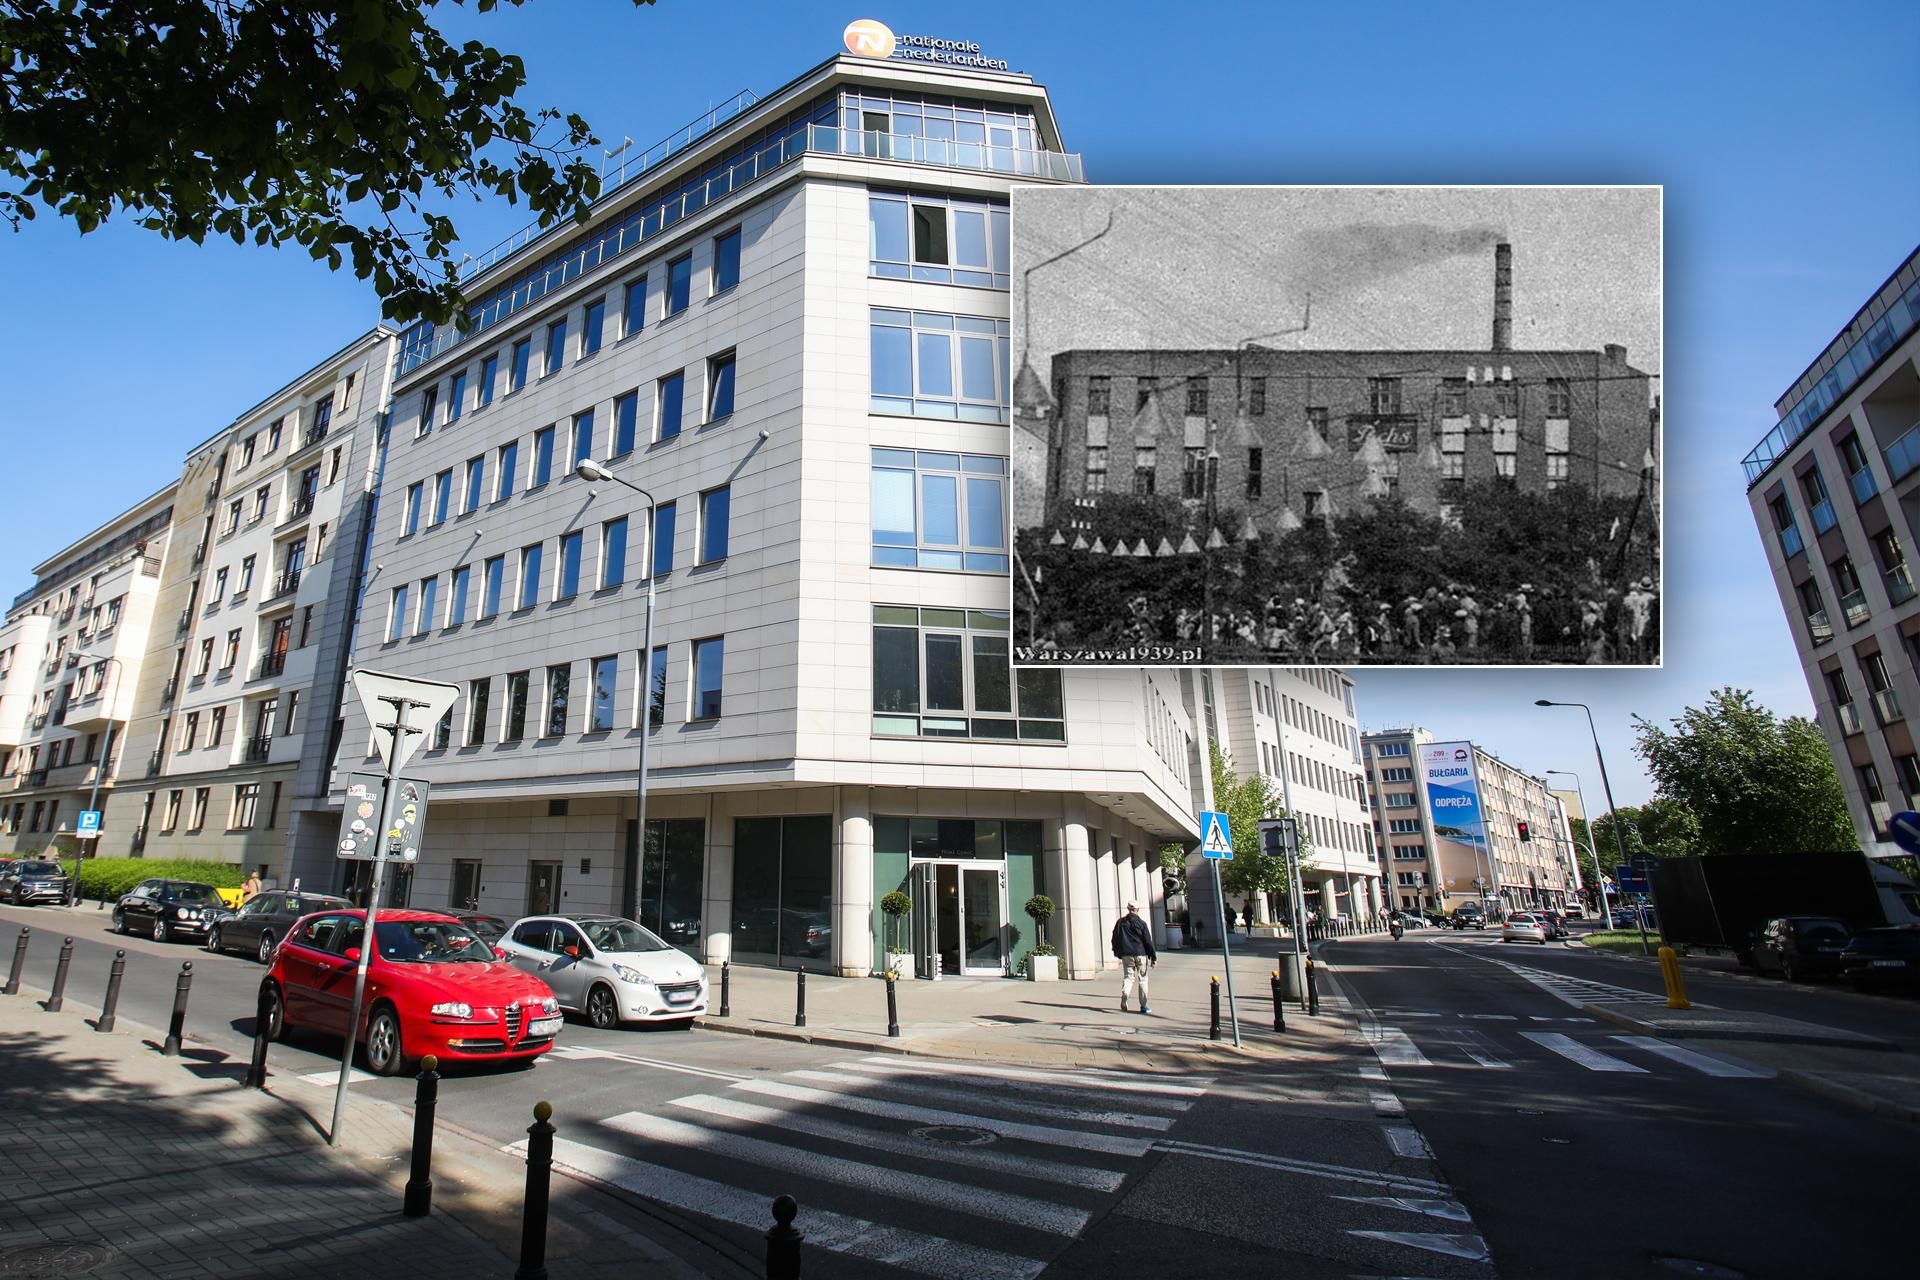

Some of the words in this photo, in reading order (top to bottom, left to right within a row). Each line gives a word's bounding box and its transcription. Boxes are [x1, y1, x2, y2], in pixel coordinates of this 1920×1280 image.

[903, 35, 980, 53] nationale
[903, 47, 1008, 70] nederlanden
[1429, 768, 1468, 778] BUŁGARIA
[1436, 795, 1472, 808] ODPRĘŻA
[82, 813, 96, 828] P
